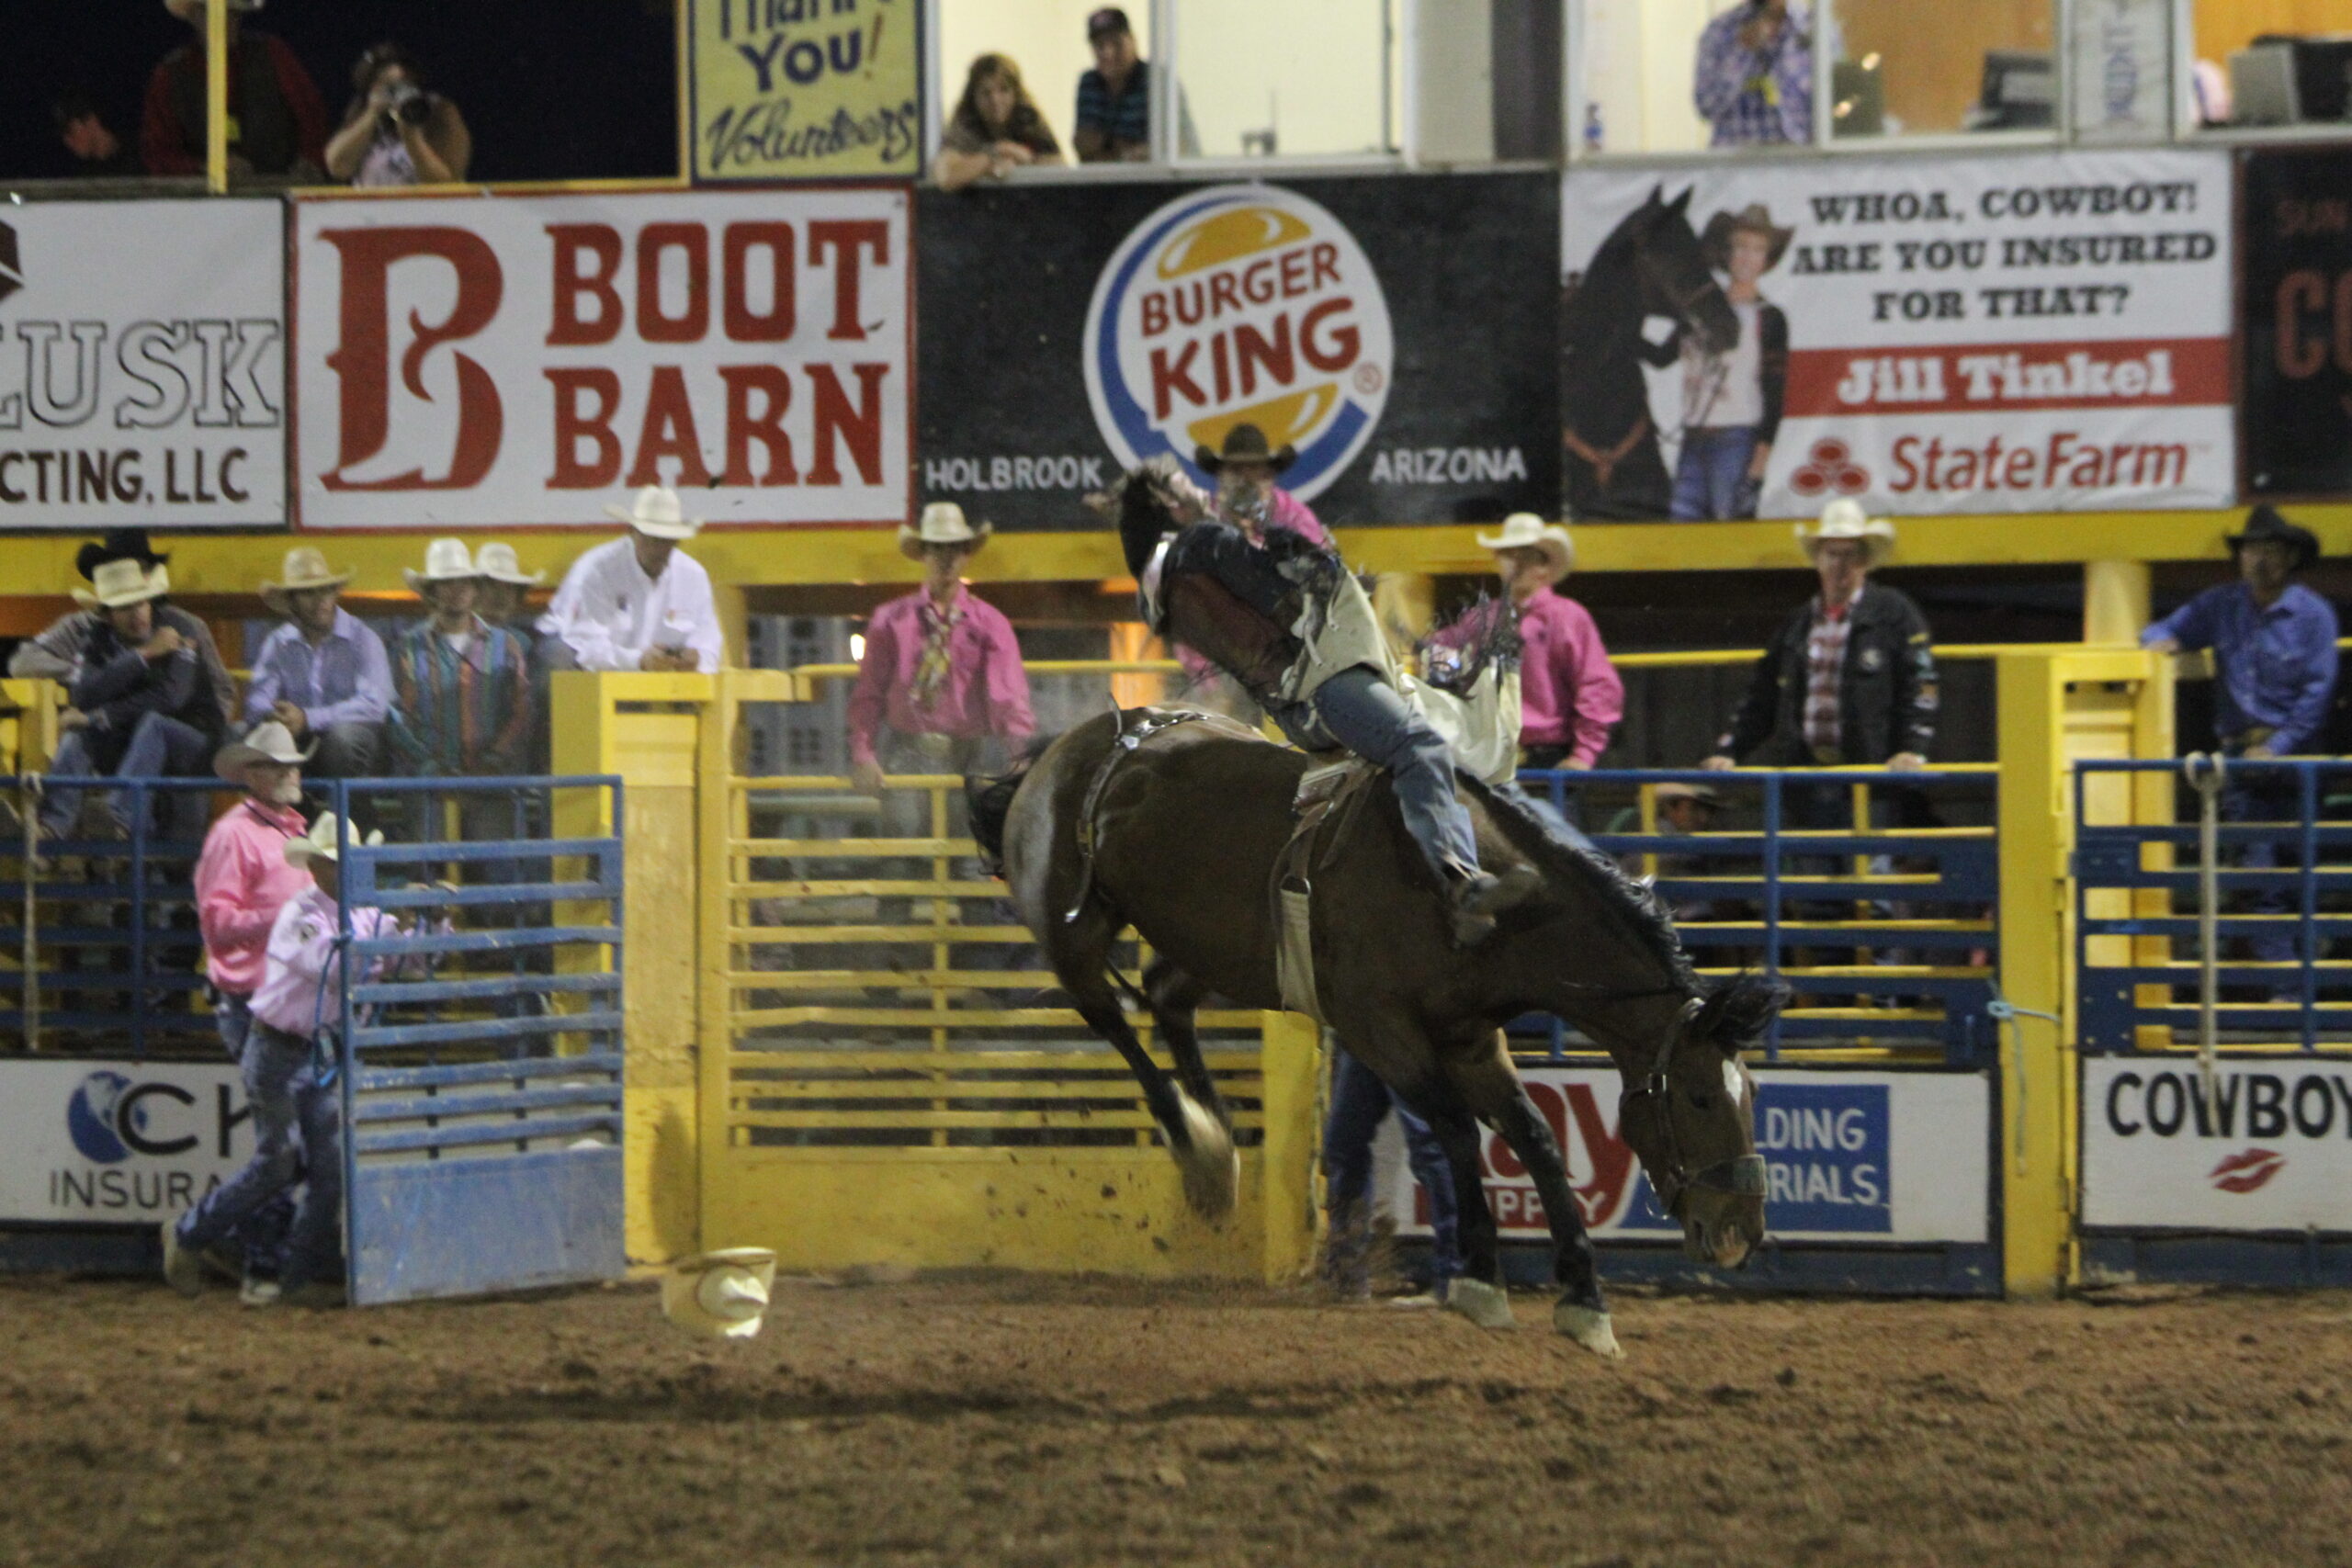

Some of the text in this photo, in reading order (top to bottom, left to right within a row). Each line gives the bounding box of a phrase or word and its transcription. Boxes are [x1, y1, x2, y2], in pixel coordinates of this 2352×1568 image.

[738, 13, 885, 92] YOU!
[1810, 184, 2198, 223] WHOA, COWBOY!
[1792, 231, 2217, 275] ARE YOU INSURED
[544, 220, 890, 346] BOOT
[1141, 242, 1342, 339] BURGER
[1872, 285, 2130, 321] FOR THAT?
[1150, 296, 1362, 421] KING
[1838, 350, 2175, 404] Jill Tinkel
[543, 363, 891, 490] BARN
[925, 455, 1104, 491] HOLBROOK
[1369, 445, 1528, 484] ARIZONA
[1765, 1162, 1879, 1206] RIALS
